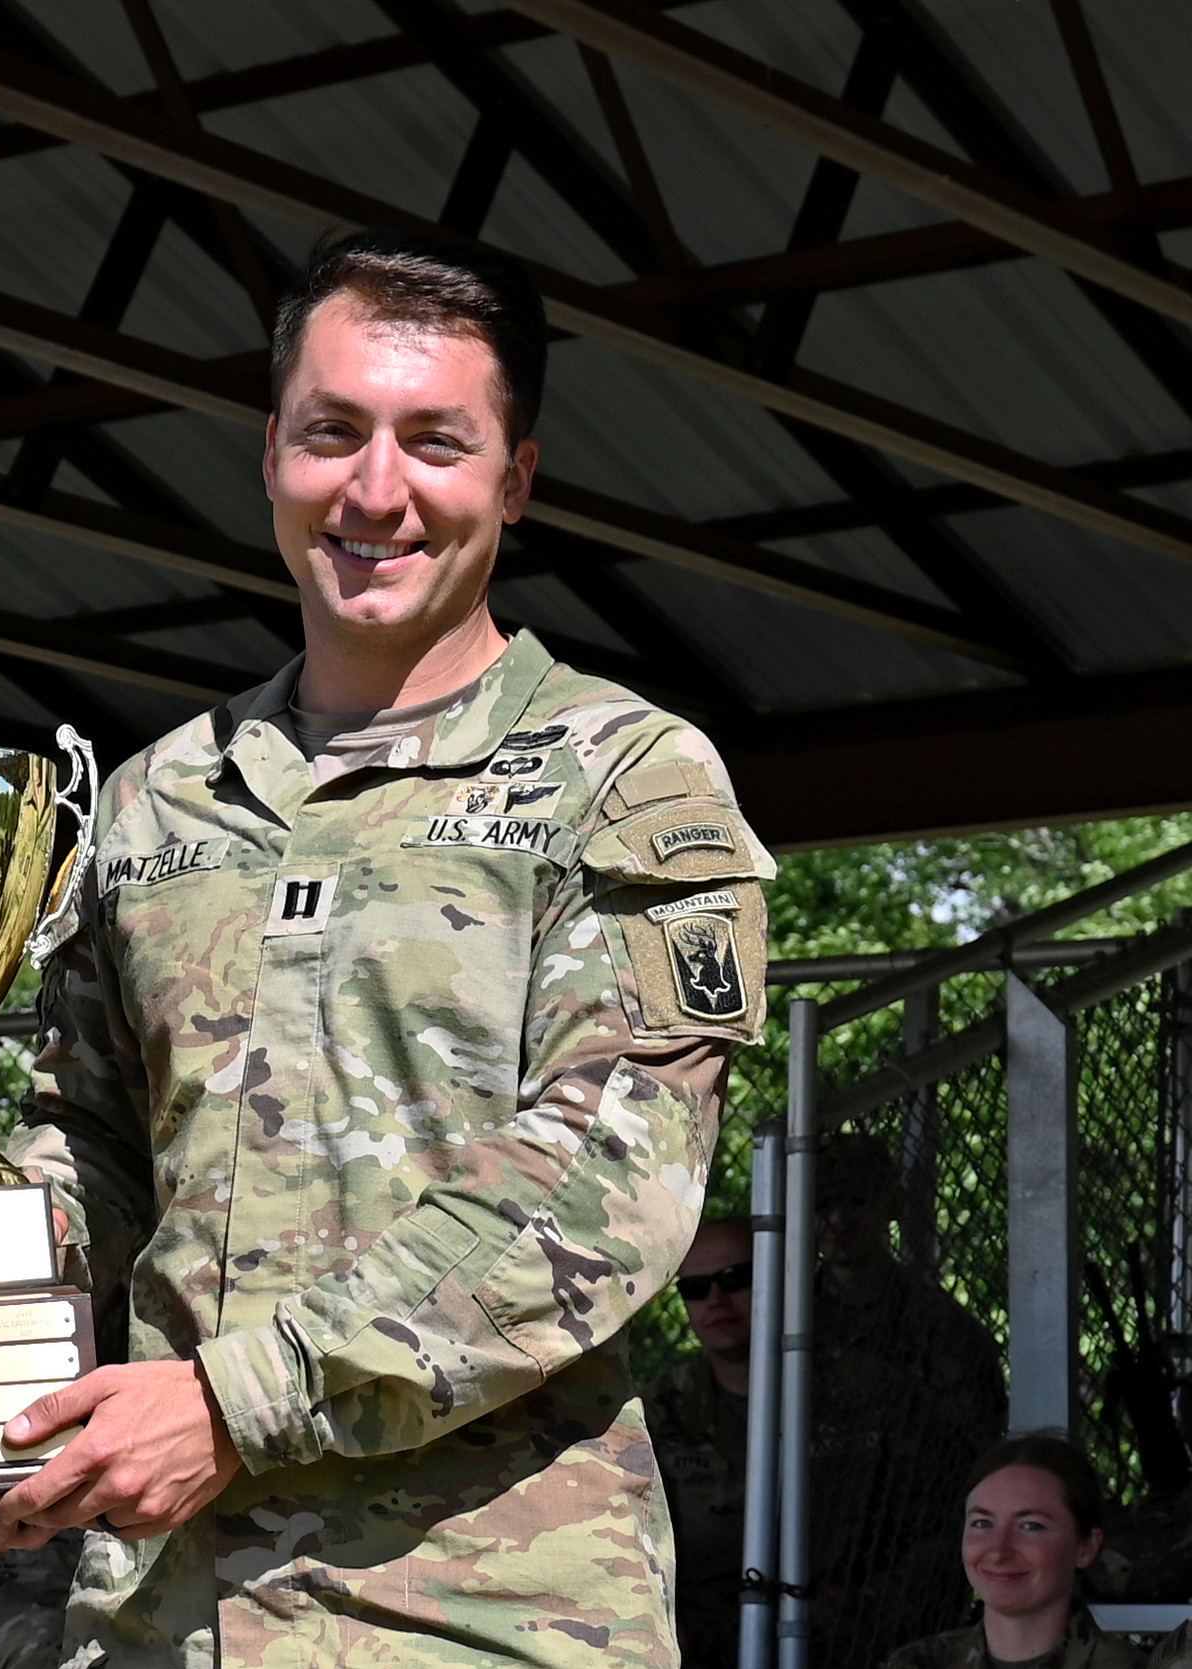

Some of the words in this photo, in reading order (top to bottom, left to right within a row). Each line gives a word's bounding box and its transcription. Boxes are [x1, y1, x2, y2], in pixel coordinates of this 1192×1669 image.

[427, 818, 468, 842] U.S.
[481, 820, 561, 854] ARMY
[661, 828, 722, 849] RANGER
[105, 841, 209, 890] MATZELLE
[653, 893, 732, 917] MOUNTAIN
